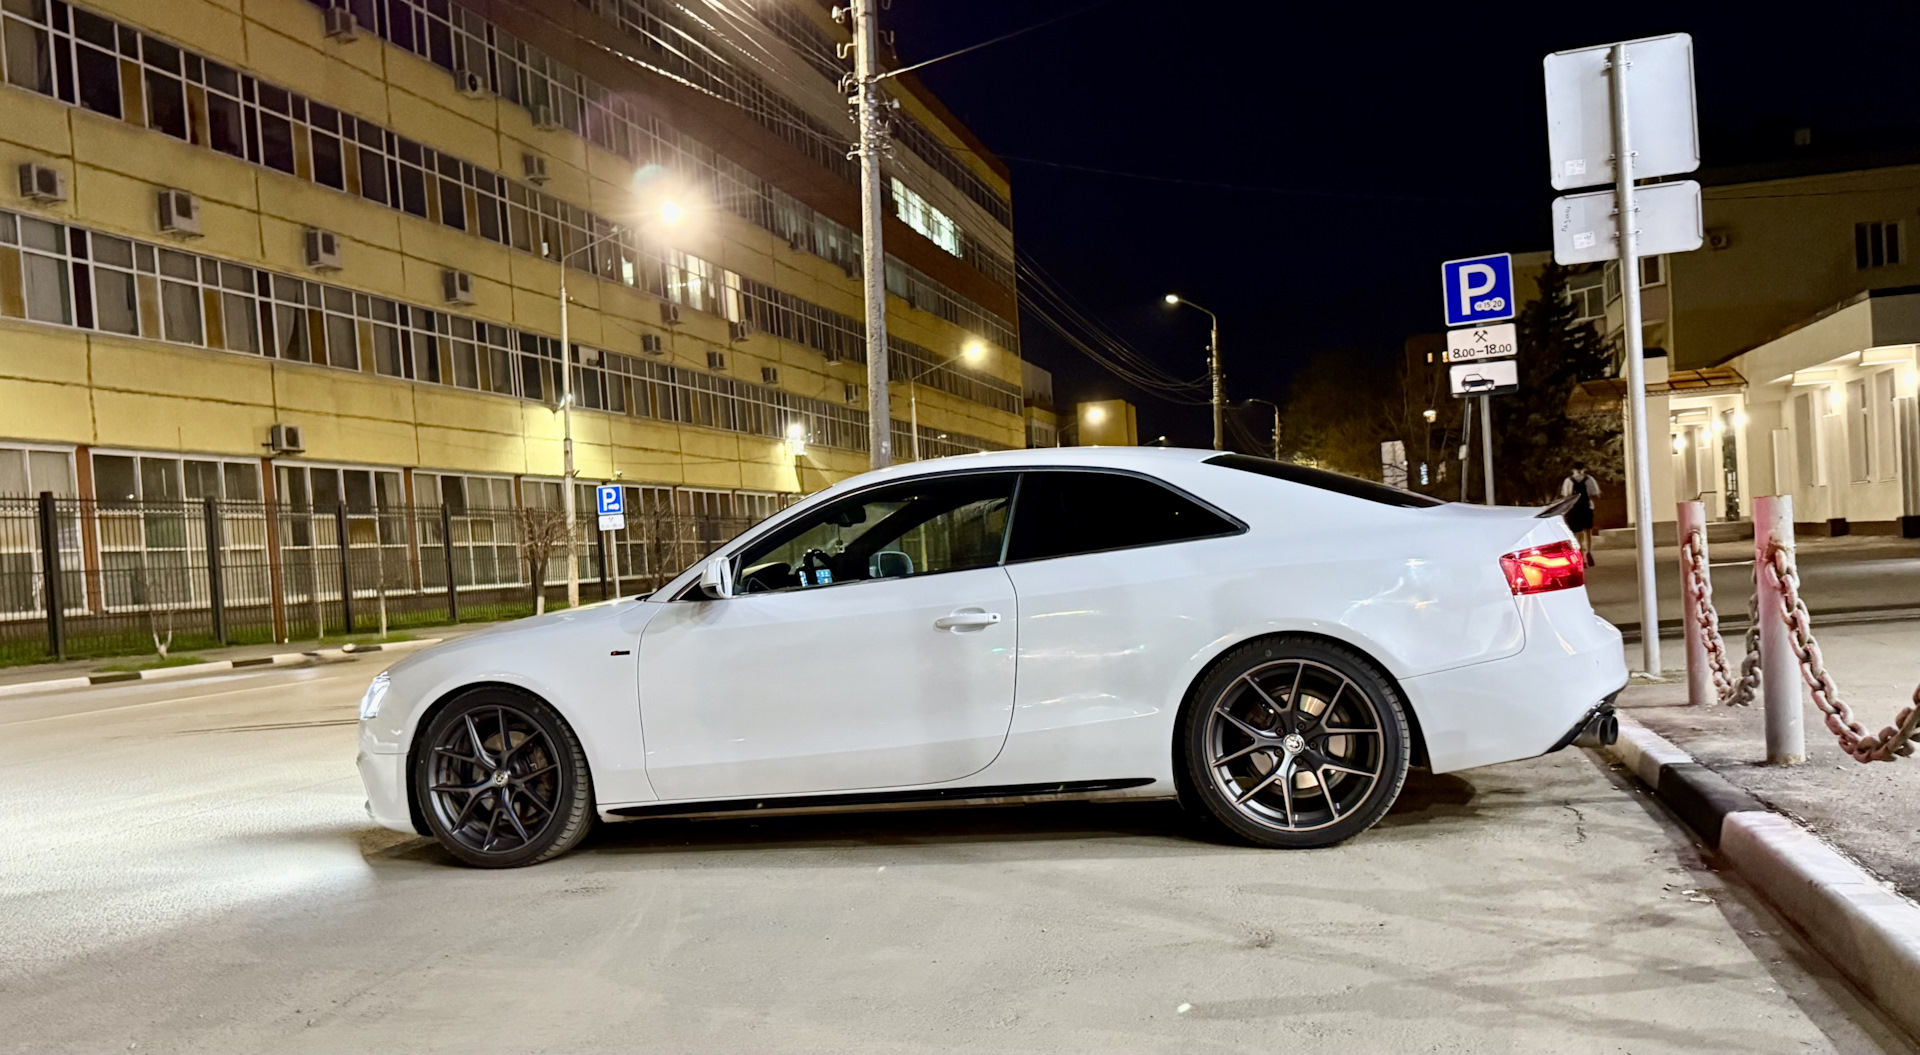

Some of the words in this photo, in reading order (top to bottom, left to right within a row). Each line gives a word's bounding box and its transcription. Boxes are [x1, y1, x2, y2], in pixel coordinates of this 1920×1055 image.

[1459, 263, 1496, 316] P
[1493, 300, 1503, 308] 20
[602, 488, 616, 511] P
